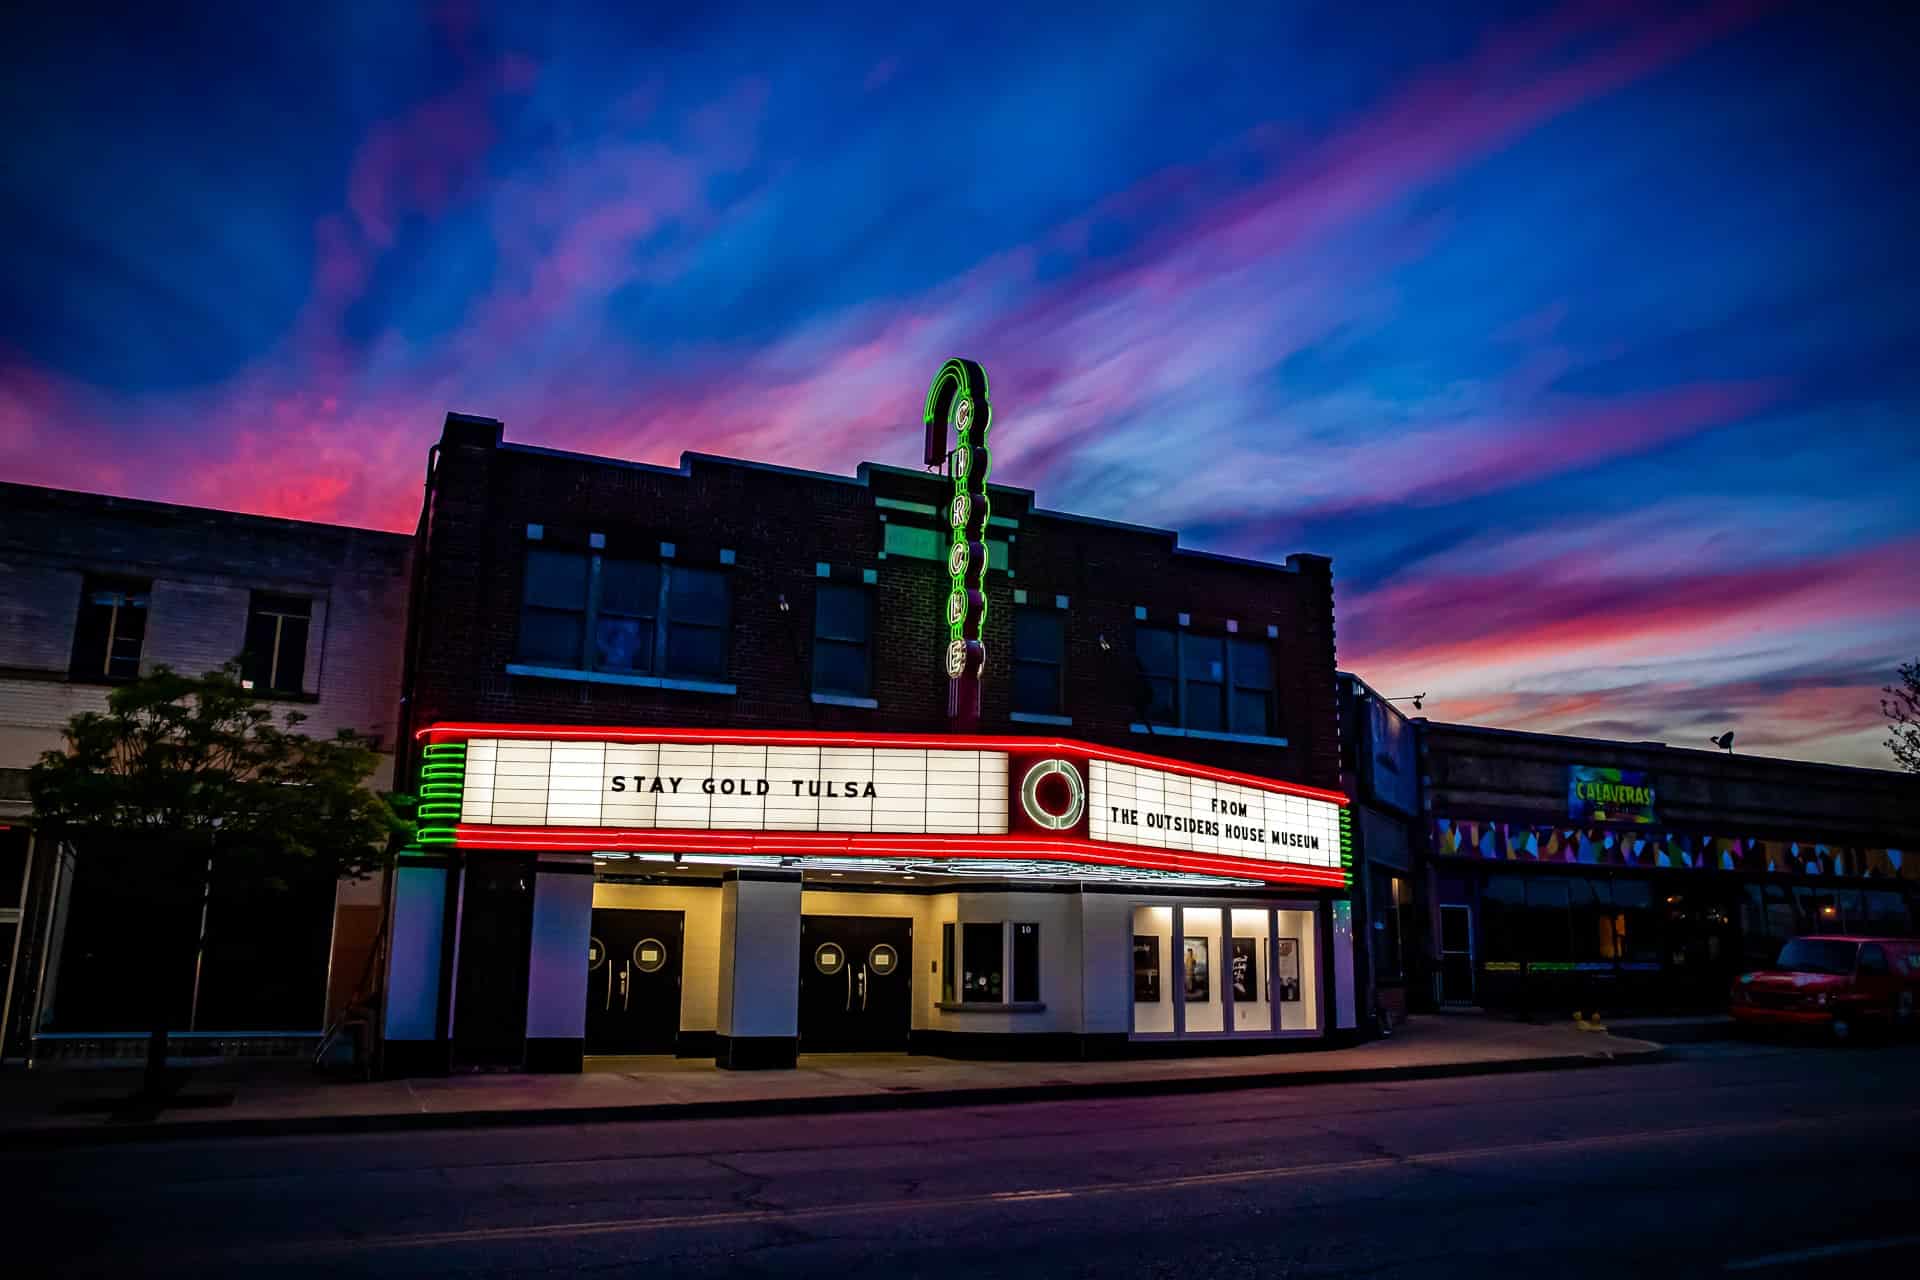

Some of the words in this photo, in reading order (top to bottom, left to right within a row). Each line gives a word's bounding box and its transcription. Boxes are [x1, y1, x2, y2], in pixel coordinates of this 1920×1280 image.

[611, 775, 682, 794] STAY
[702, 778, 770, 795] GOLD
[792, 780, 877, 797] TULSA
[1576, 782, 1650, 806] CALAVERAS
[1211, 798, 1248, 818] FROM
[1111, 806, 1139, 826] THE
[1146, 812, 1219, 837] OUTSIDERS
[1225, 823, 1265, 843] HOUSE
[1271, 830, 1320, 850] MUSEUM
